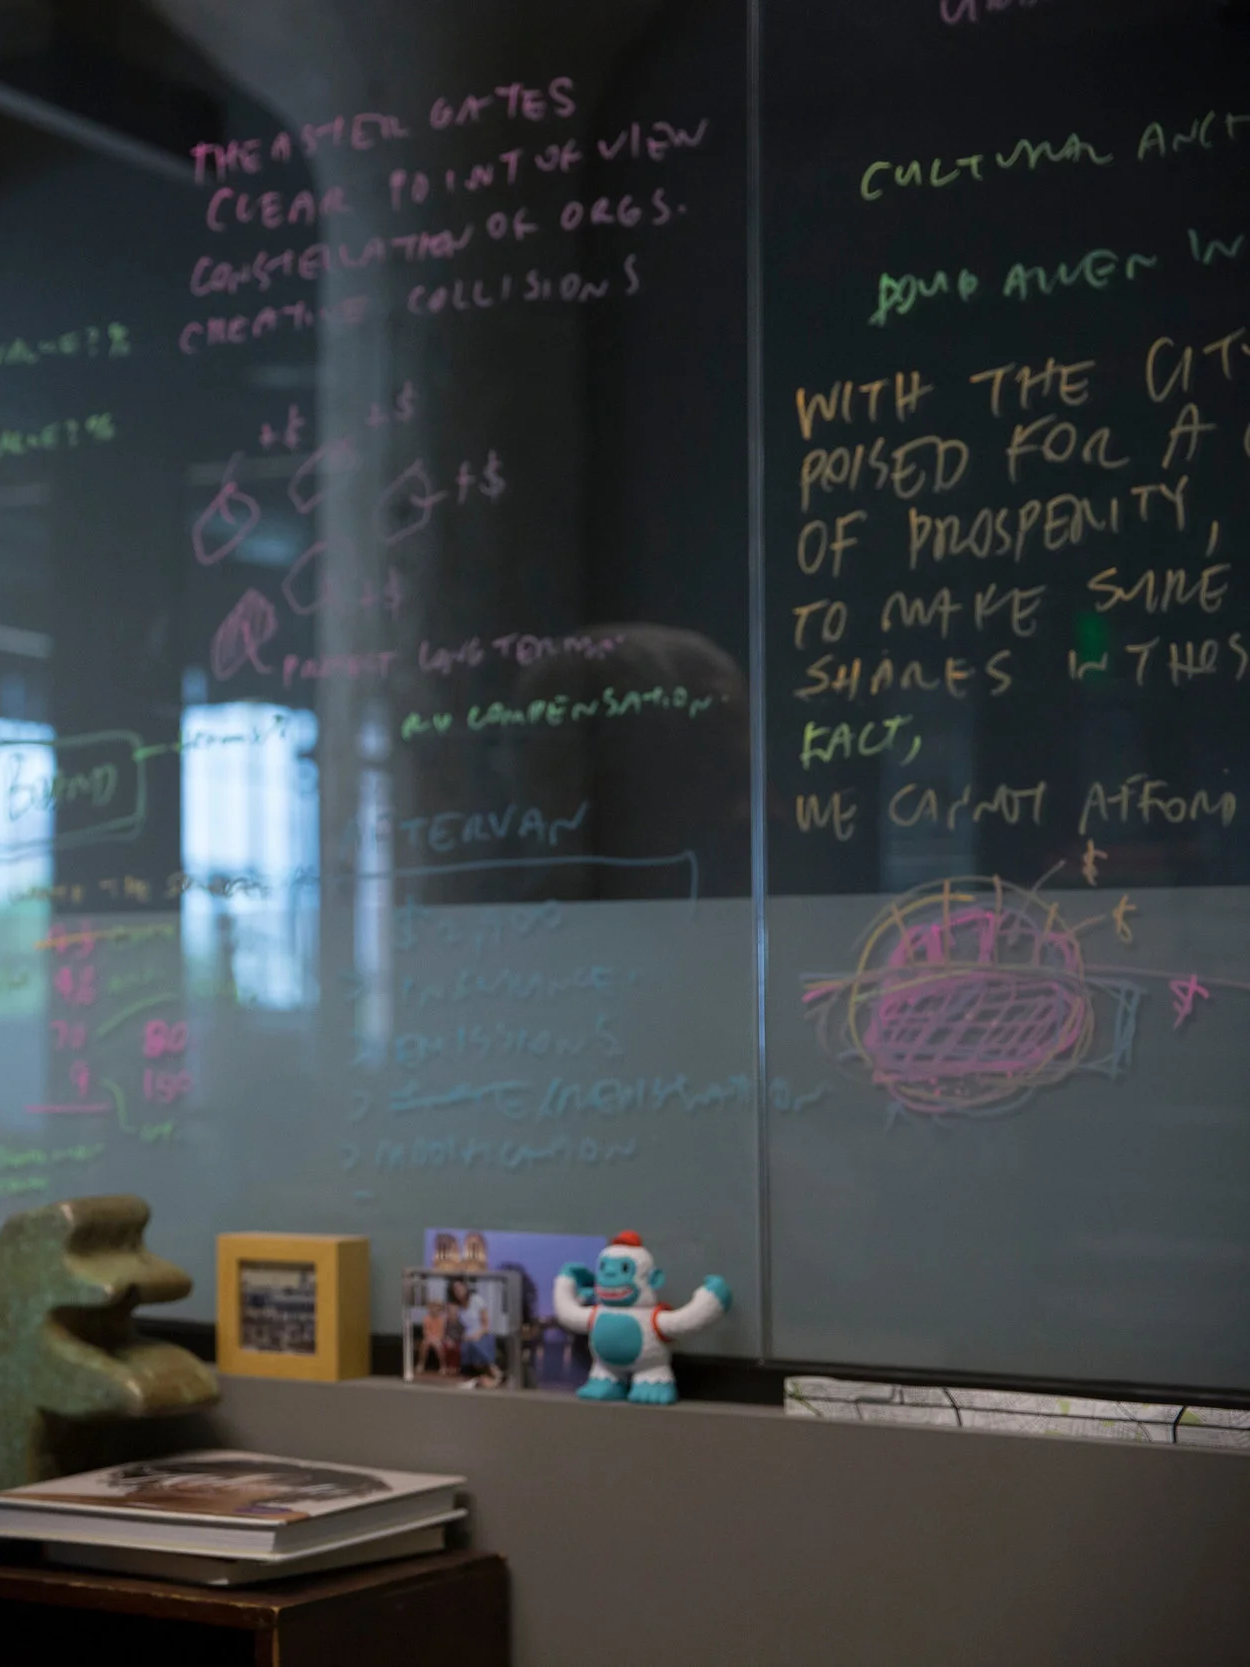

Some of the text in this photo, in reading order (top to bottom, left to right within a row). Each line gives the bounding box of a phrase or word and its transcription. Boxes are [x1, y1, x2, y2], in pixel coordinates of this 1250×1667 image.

[429, 75, 577, 130] GATES
[205, 117, 710, 233] CLEAR POINT OF VIEW
[861, 133, 1114, 200] CULTURAL
[486, 206, 539, 241] OF
[407, 252, 640, 315] COLLISIONS
[795, 327, 1250, 441] WITH THE CIT
[799, 434, 969, 514] POISED
[1005, 413, 1131, 485] FOR
[1161, 401, 1218, 470] A
[797, 510, 868, 579] OF
[793, 563, 1232, 651] TO MAKE SURE
[793, 648, 1012, 701] SHARES
[796, 788, 857, 841] WE
[1077, 772, 1237, 836] AFFORD
